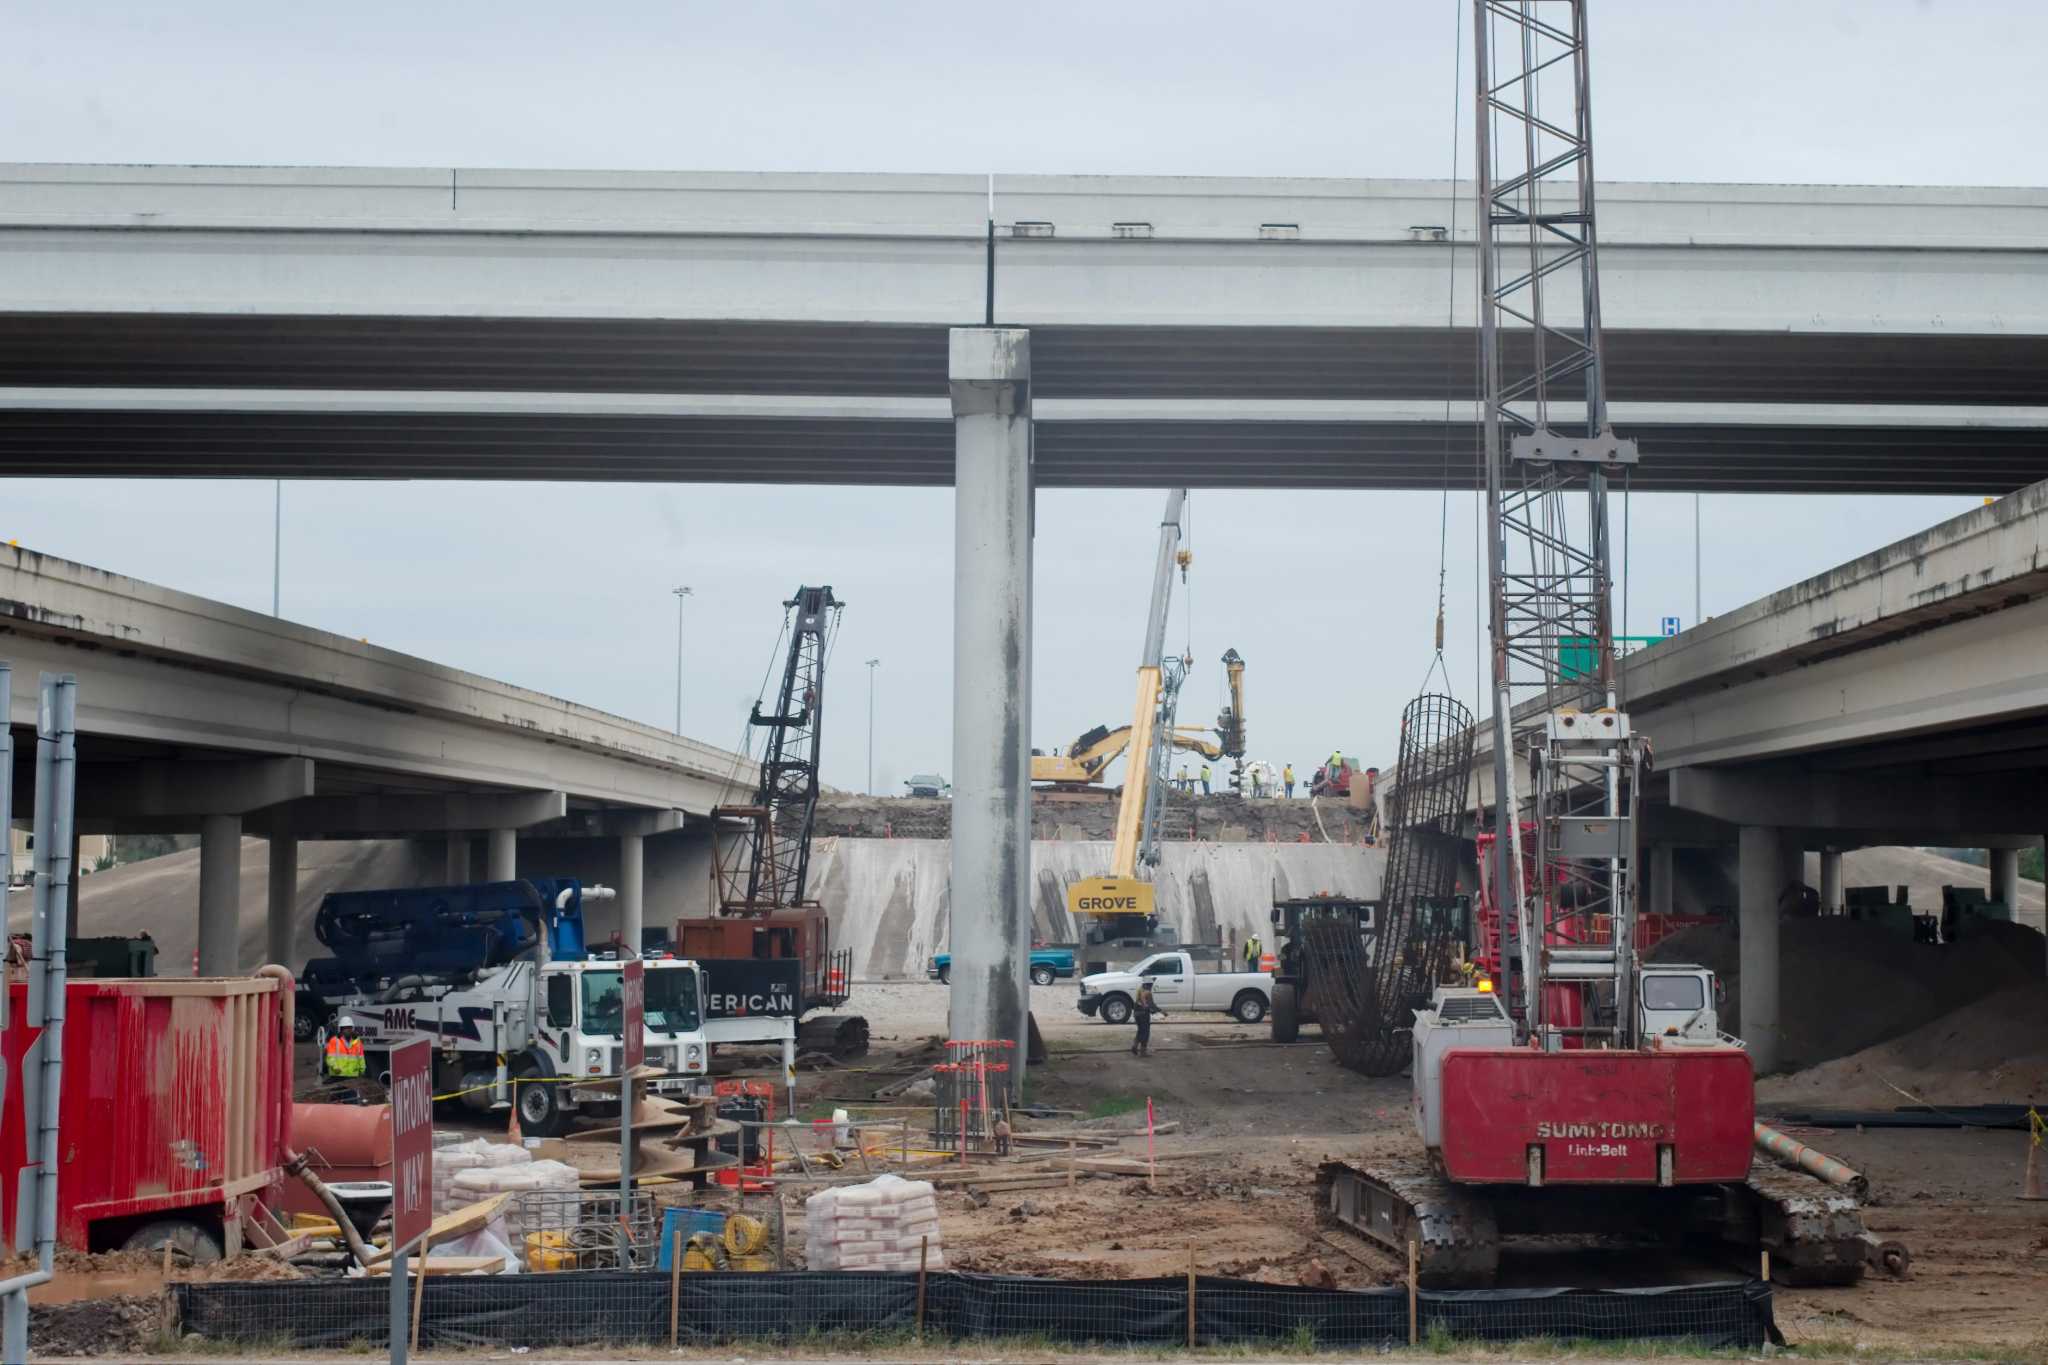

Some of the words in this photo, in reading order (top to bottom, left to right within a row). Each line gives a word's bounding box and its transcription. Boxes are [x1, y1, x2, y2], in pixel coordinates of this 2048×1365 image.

[1078, 897, 1137, 909] GROVE
[704, 994, 793, 1011] ERICAN
[384, 1008, 416, 1029] RME
[394, 1070, 430, 1137] WRONG
[403, 1151, 424, 1216] WAY
